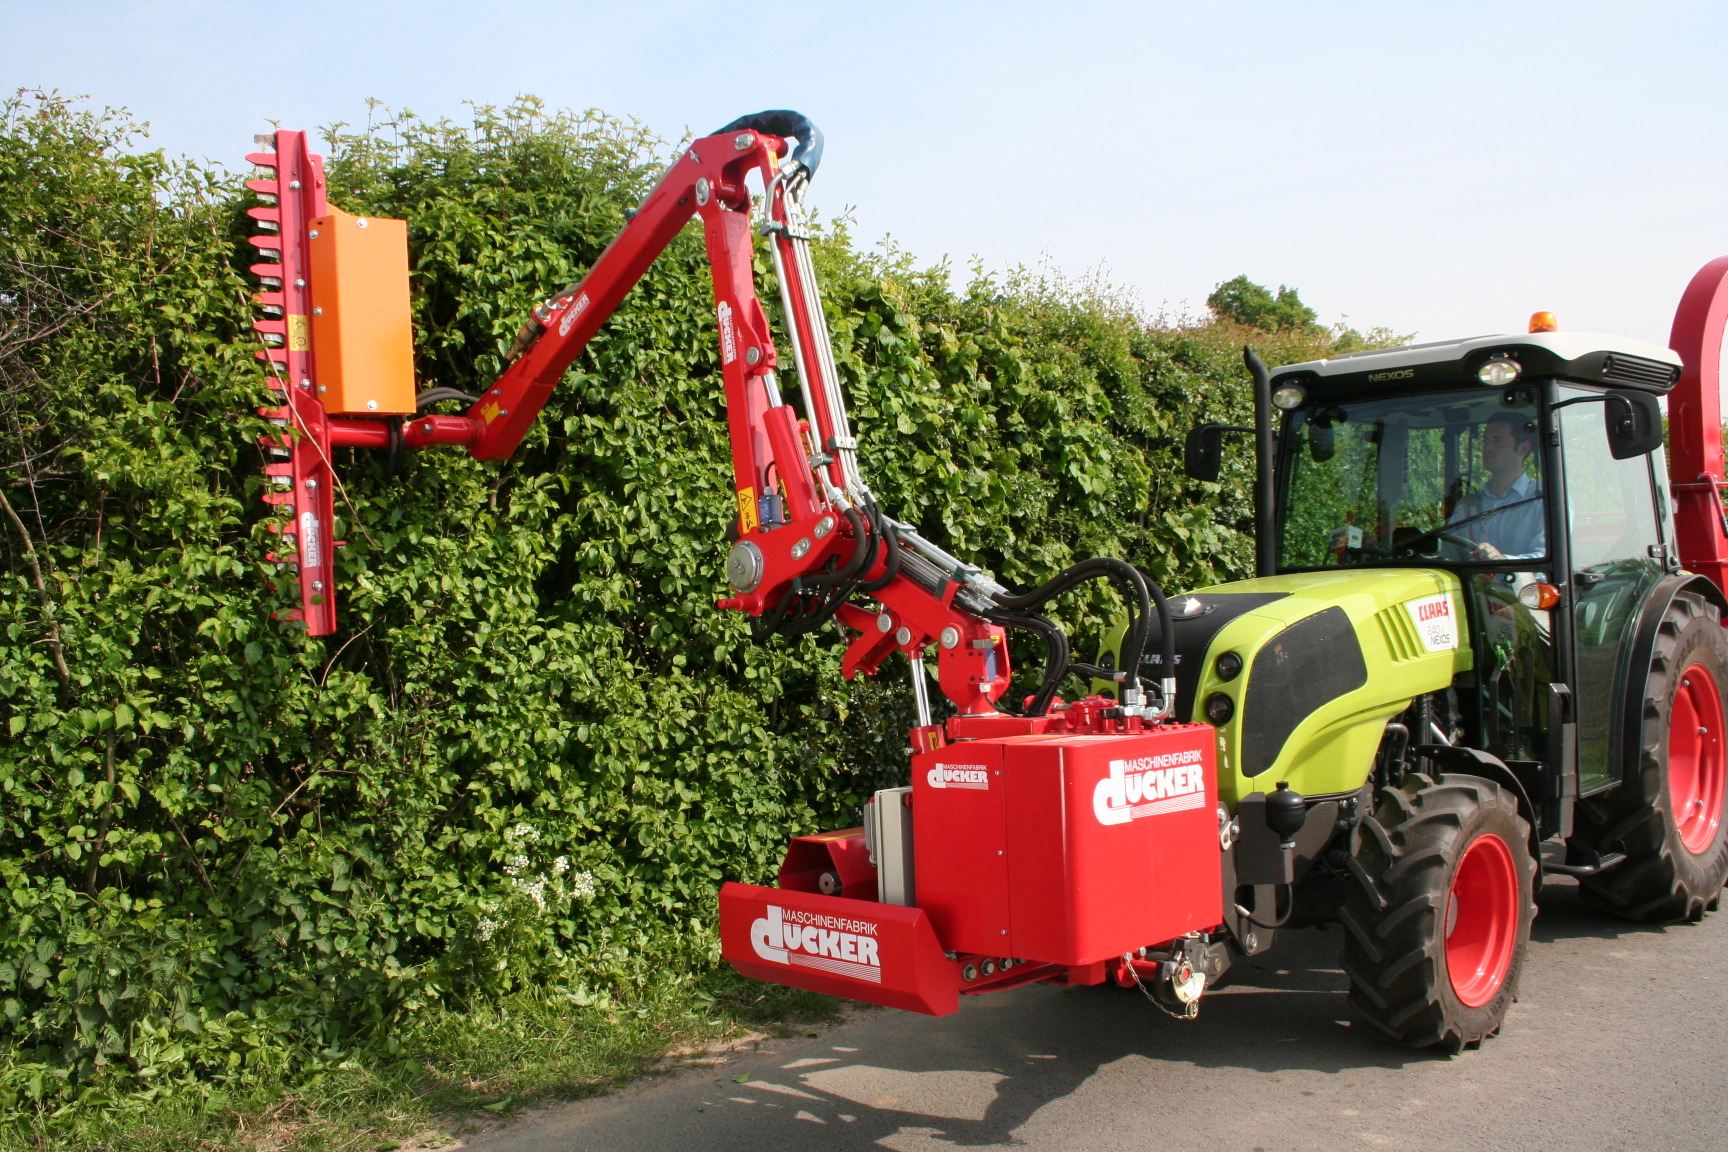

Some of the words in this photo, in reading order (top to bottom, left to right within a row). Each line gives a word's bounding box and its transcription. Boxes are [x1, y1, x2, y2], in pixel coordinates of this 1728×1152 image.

[1368, 369, 1414, 382] NEXOS
[1418, 600, 1449, 622] CLAAS
[1431, 633, 1450, 645] NEXOS
[1125, 749, 1203, 773] MASCHINENFABRIK
[782, 908, 878, 936] MASCHINENFABRIK
